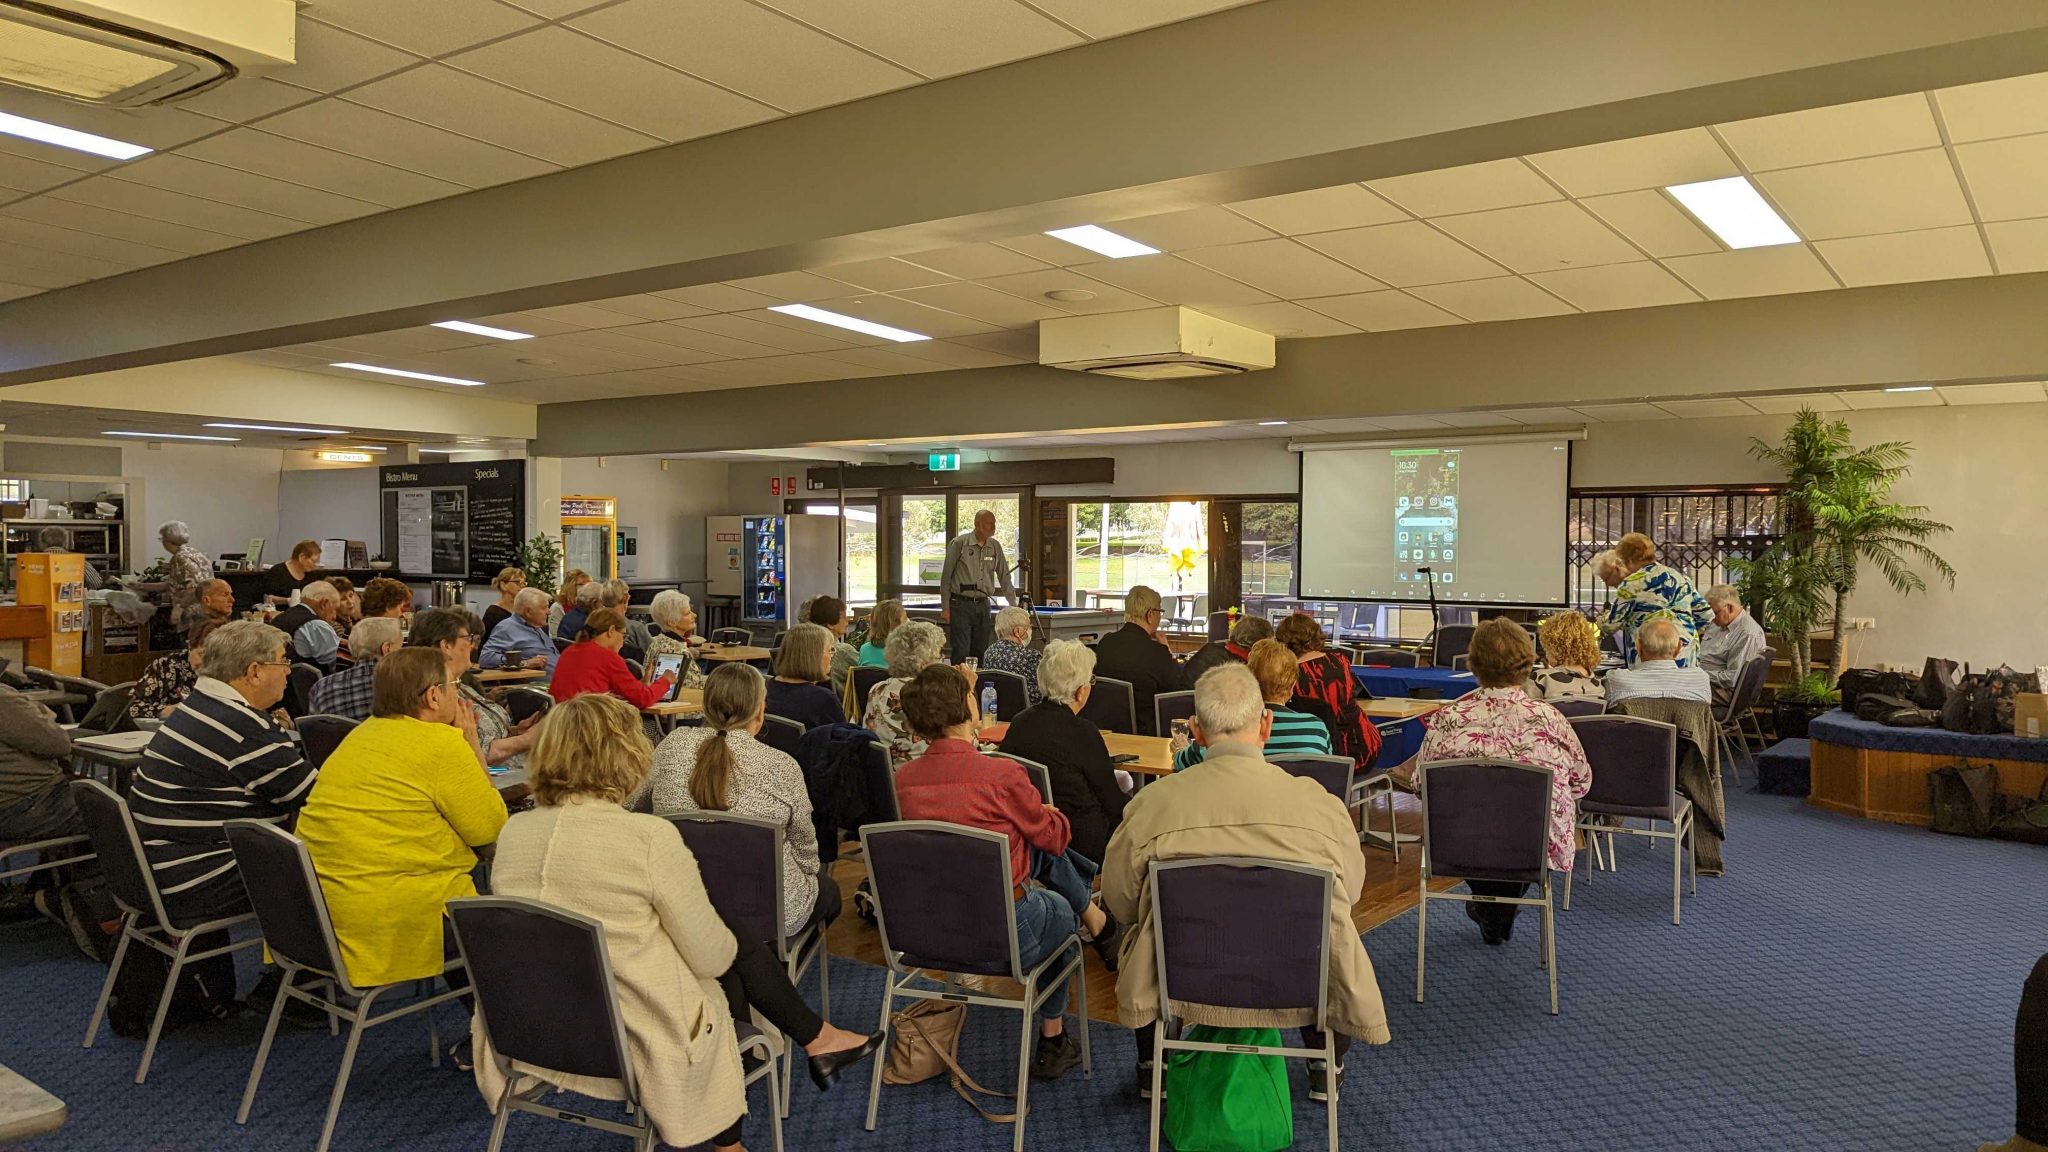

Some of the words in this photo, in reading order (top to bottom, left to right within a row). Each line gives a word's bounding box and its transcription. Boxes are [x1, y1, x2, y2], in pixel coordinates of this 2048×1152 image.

[329, 453, 364, 461] GENTS
[386, 472, 401, 482] Bistro
[402, 471, 418, 481] Menu
[474, 467, 499, 481] Specials
